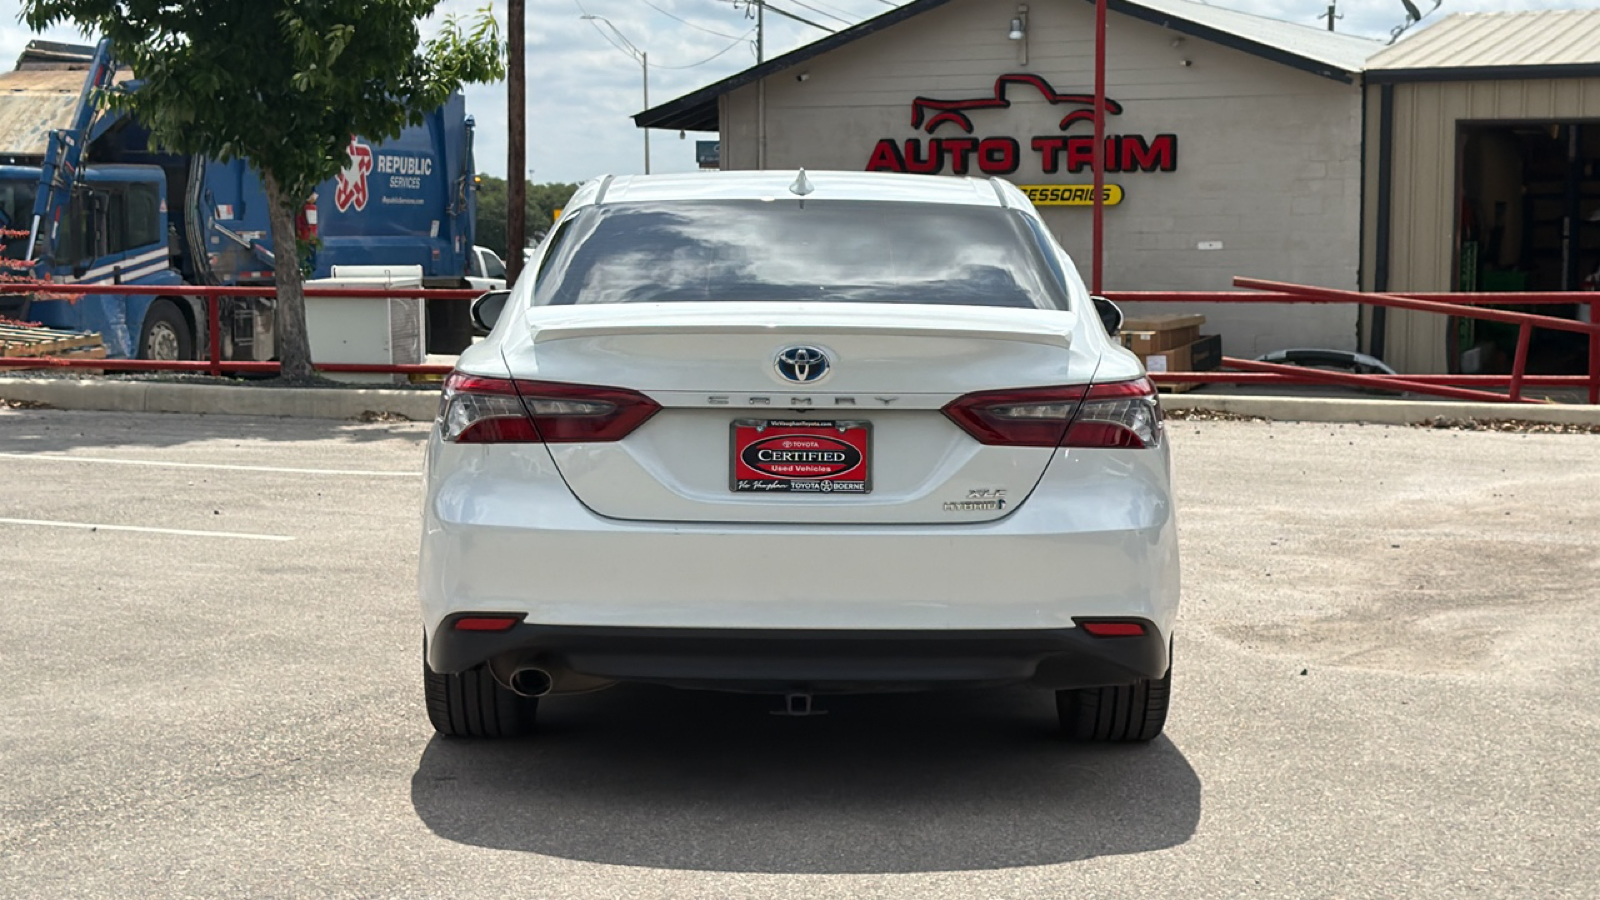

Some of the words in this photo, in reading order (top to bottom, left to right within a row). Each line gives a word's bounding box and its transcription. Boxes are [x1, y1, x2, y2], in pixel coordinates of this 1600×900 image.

[865, 137, 1020, 175] AUTO
[1031, 134, 1177, 174] TRIM
[377, 155, 432, 175] REPUBLIC
[389, 176, 420, 189] SERVICES
[708, 395, 899, 406] CAMRY
[758, 449, 845, 462] CERTIFIED
[771, 464, 793, 472] Used
[795, 464, 831, 472] Vehicles
[966, 488, 1007, 499] XLE
[943, 500, 997, 511] HYBRID
